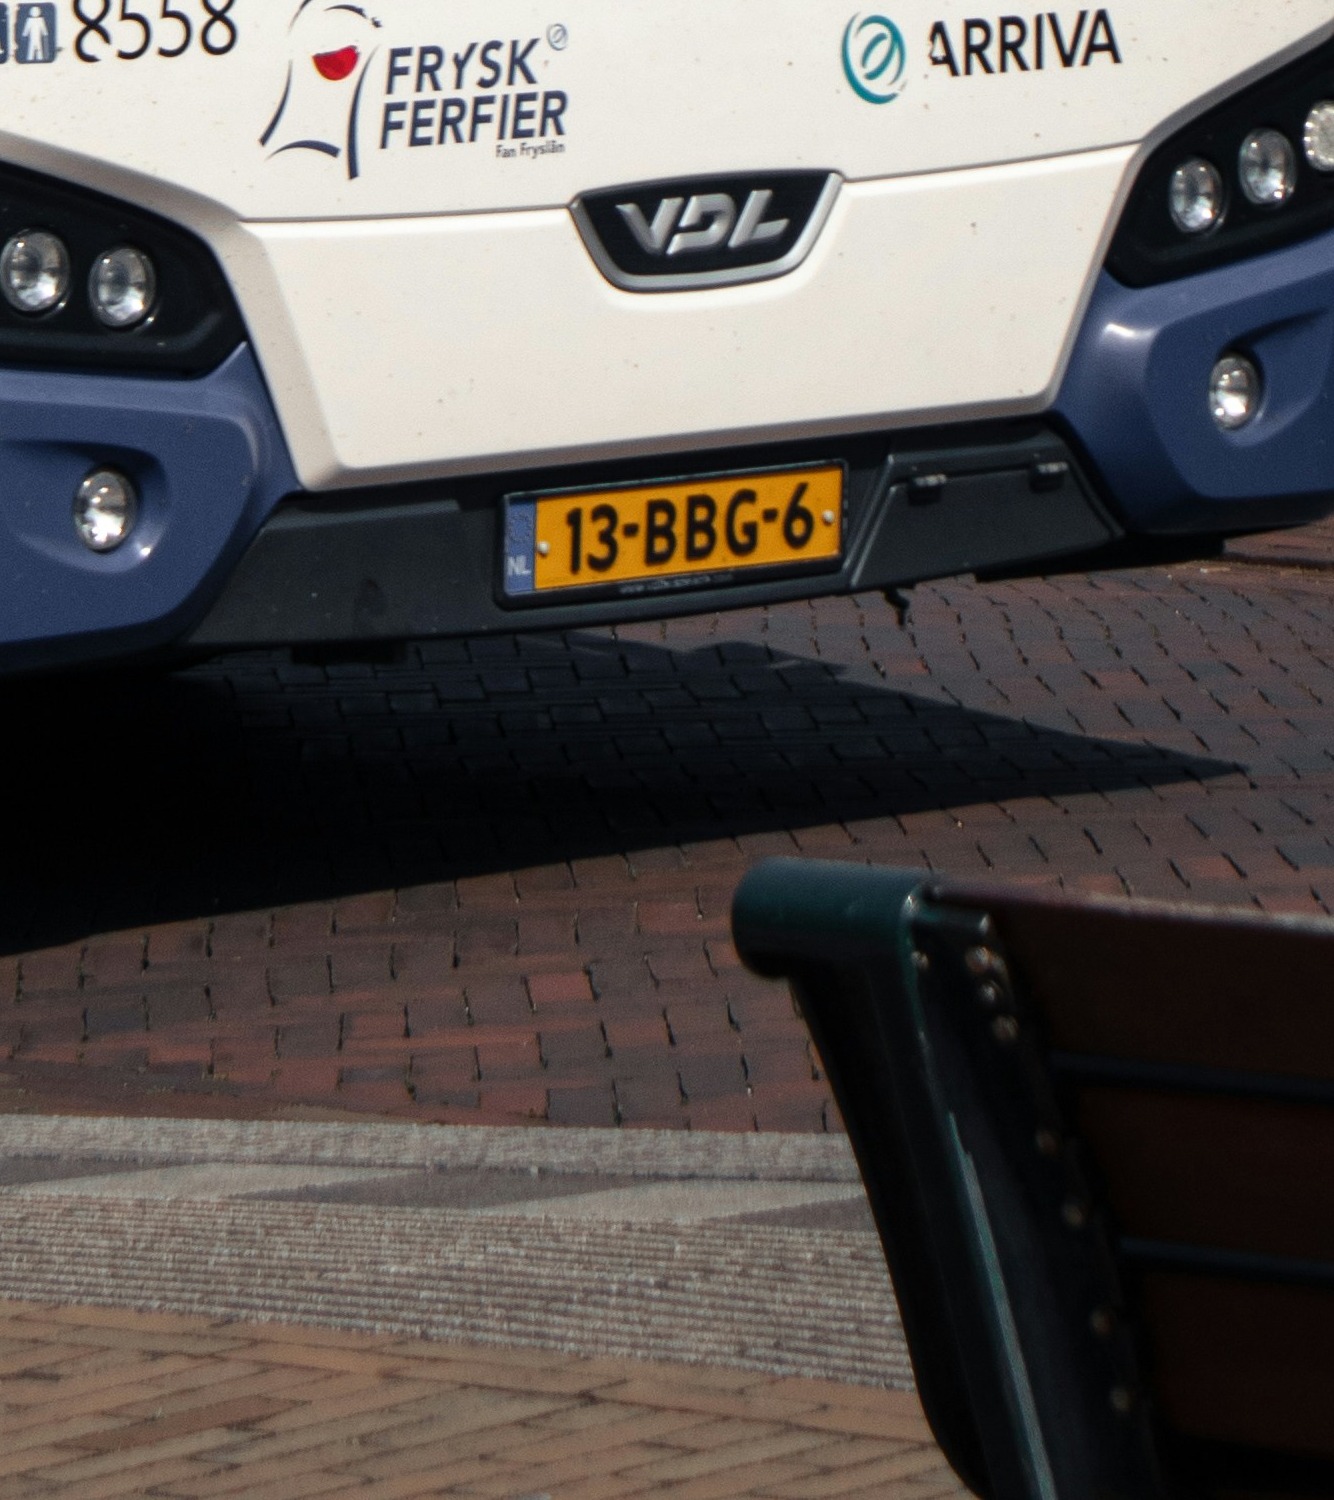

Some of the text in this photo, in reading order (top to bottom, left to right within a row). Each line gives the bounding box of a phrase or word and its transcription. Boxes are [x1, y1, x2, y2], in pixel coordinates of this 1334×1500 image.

[385, 37, 541, 95] FRYSK
[928, 8, 1123, 77] ARRIVA
[379, 89, 568, 150] FERFIER
[615, 189, 791, 256] VDL
[566, 482, 815, 575] 13-BBG-6
[507, 555, 532, 577] NL
